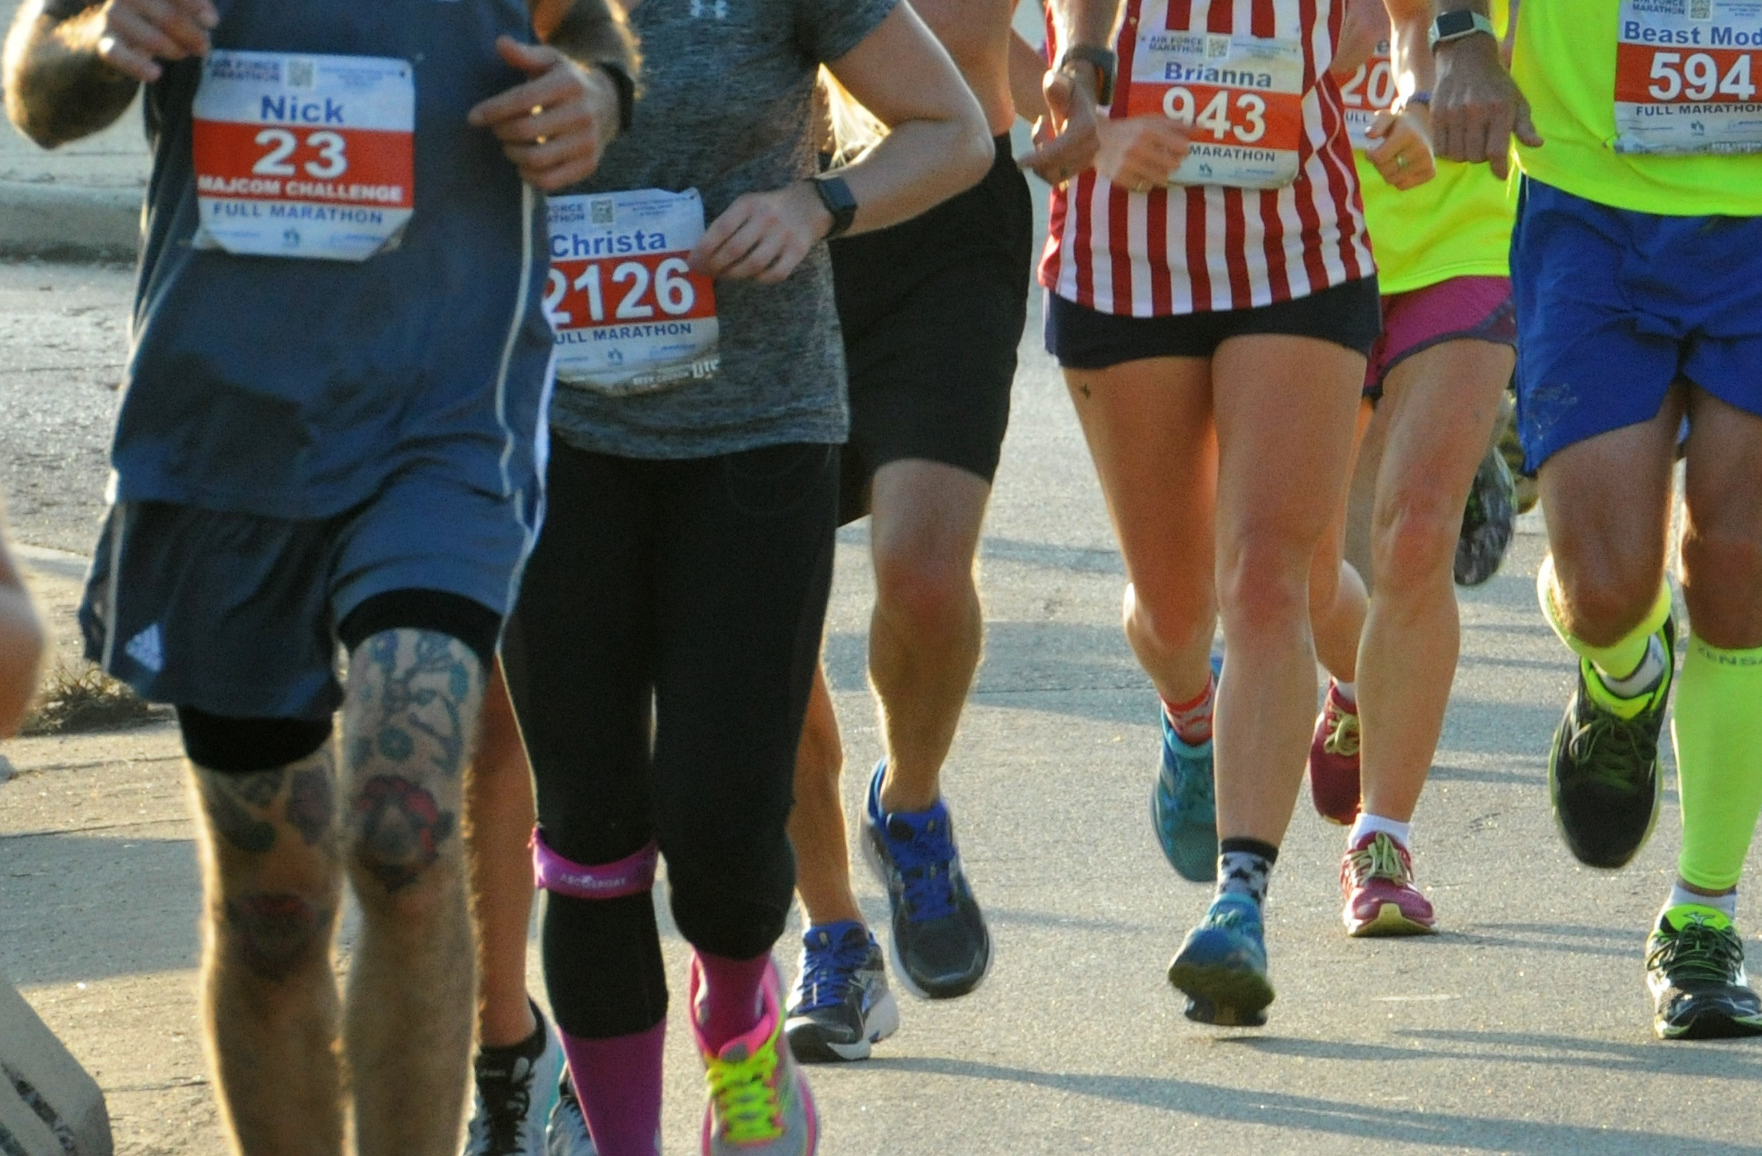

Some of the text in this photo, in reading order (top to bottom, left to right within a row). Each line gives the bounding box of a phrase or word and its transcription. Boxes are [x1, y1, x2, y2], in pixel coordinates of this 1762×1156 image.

[1632, 3, 1685, 16] MARATHON
[1624, 20, 1700, 44] Beast
[1149, 44, 1204, 53] MARATHON
[1164, 60, 1272, 88] Brianna
[1648, 51, 1756, 101] 594
[261, 95, 344, 123] Nick
[1163, 86, 1266, 143] 943
[1346, 112, 1369, 123] ULL
[1636, 106, 1673, 117] FULL
[252, 128, 348, 179] 23
[1189, 145, 1275, 162] MARATHON
[198, 175, 403, 202] MAJCOM CHALLENGE
[213, 203, 382, 224] FULL MARATHON
[551, 230, 667, 257] Christa
[545, 257, 695, 325] 2126
[553, 323, 692, 345] ULL MARATHON
